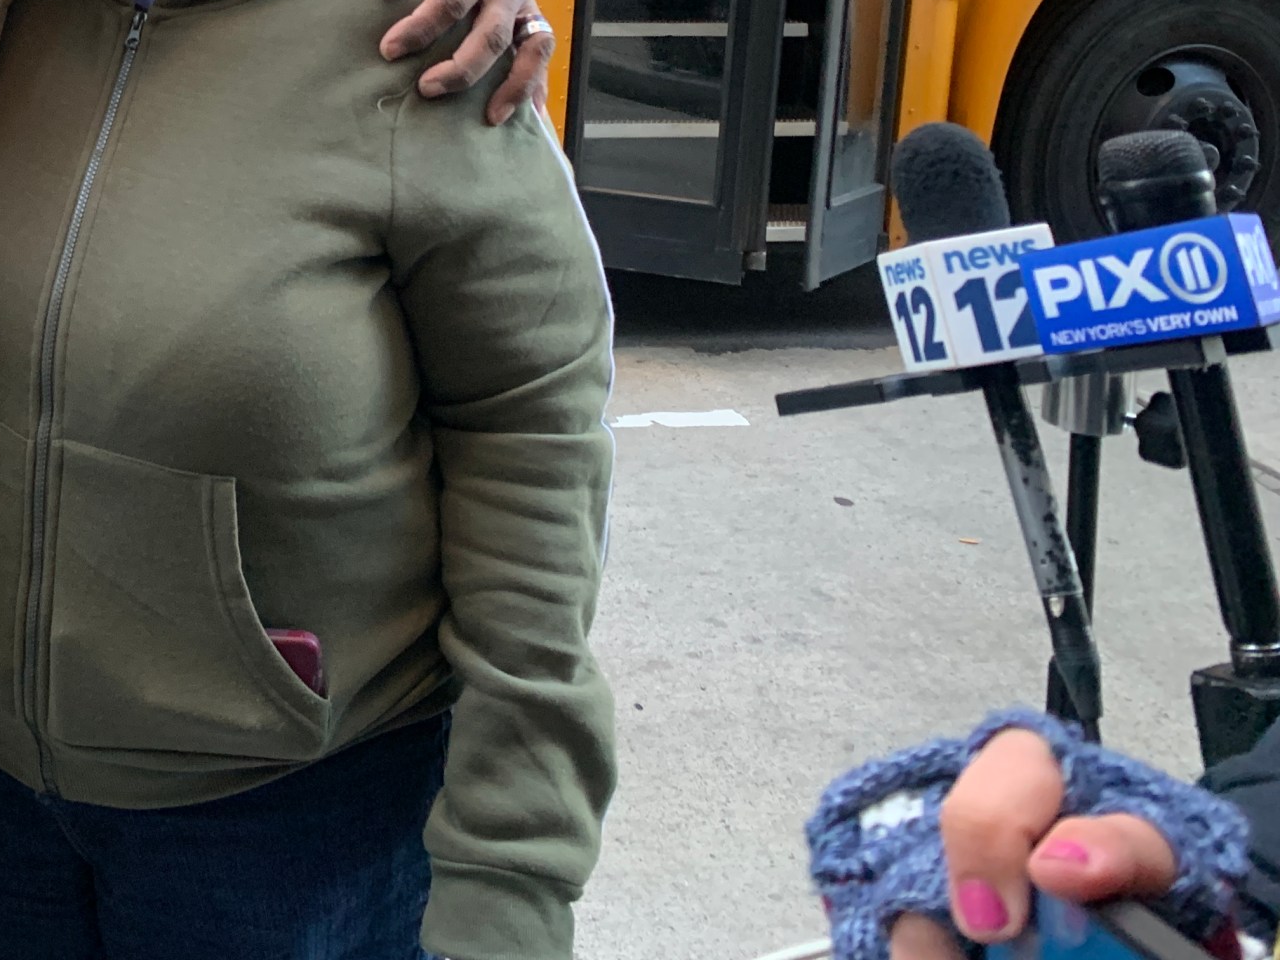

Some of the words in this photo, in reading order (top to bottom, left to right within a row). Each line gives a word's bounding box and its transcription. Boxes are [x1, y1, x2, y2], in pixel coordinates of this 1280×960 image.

[885, 257, 926, 287] news
[1032, 247, 1170, 320] PIX
[894, 285, 948, 363] 12
[953, 268, 1043, 354] 12
[1146, 311, 1192, 333] VERY
[1193, 305, 1239, 327] OWN
